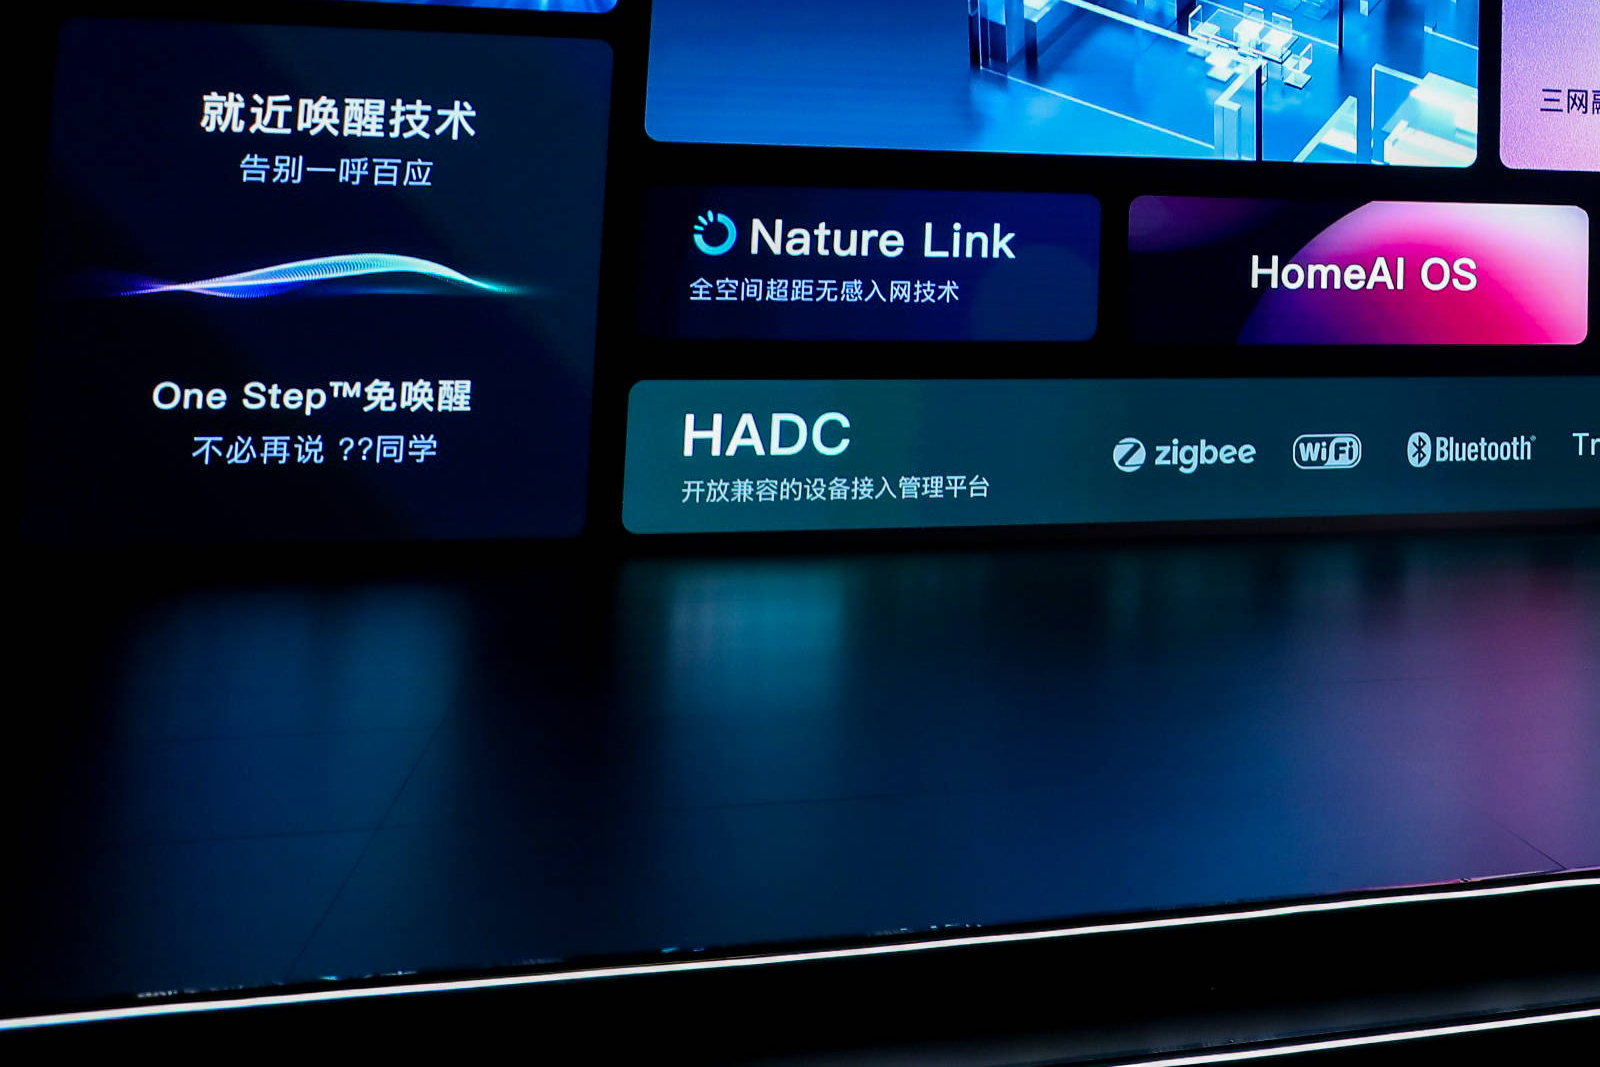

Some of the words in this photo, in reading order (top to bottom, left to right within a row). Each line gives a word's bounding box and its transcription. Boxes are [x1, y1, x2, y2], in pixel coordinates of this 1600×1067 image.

[200, 91, 477, 141] 就近唤醒技术
[239, 153, 434, 188] 告别一呼百应
[750, 219, 904, 258] Nature
[924, 222, 1016, 259] Link
[689, 277, 959, 303] 全空间超距无感入网技术
[1251, 255, 1404, 291] HomeAI
[1420, 257, 1478, 291] OS
[152, 381, 228, 410] One
[192, 435, 325, 465] 不必再说
[338, 434, 438, 464] ??同学
[683, 411, 851, 456] HADC
[1155, 438, 1257, 474] zigbee
[1299, 440, 1360, 464] WiFi
[1436, 435, 1531, 462] Bluetooth
[681, 475, 990, 503] 开放兼容的设备接入管理平台
